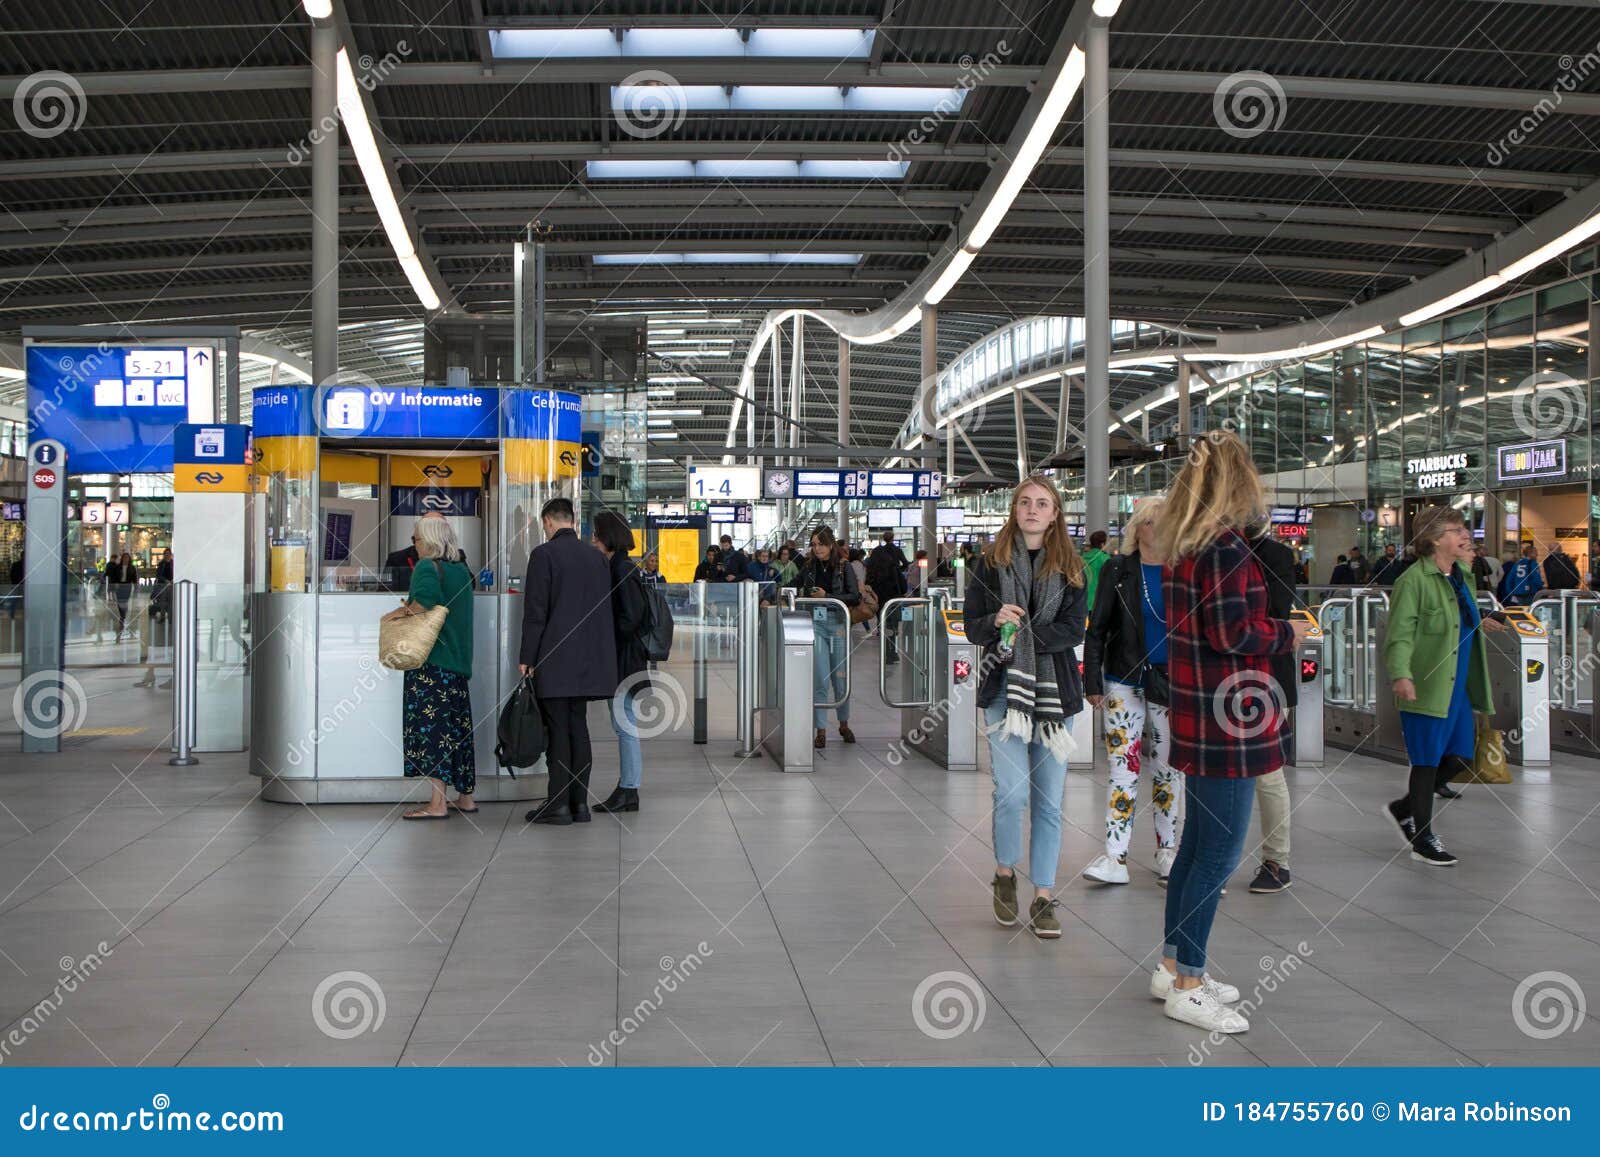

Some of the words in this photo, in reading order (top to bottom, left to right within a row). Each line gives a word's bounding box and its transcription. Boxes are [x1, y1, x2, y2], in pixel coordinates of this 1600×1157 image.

[161, 393, 181, 404] WC
[370, 391, 395, 406] OV
[401, 393, 482, 407] Informatie
[1407, 453, 1467, 474] STARBUCKS
[35, 473, 55, 483] SOS
[1418, 471, 1456, 489] COFFEE
[90, 510, 98, 521] 5
[114, 510, 122, 521] 7
[1278, 525, 1307, 536] LEON
[1516, 564, 1526, 577] 5
